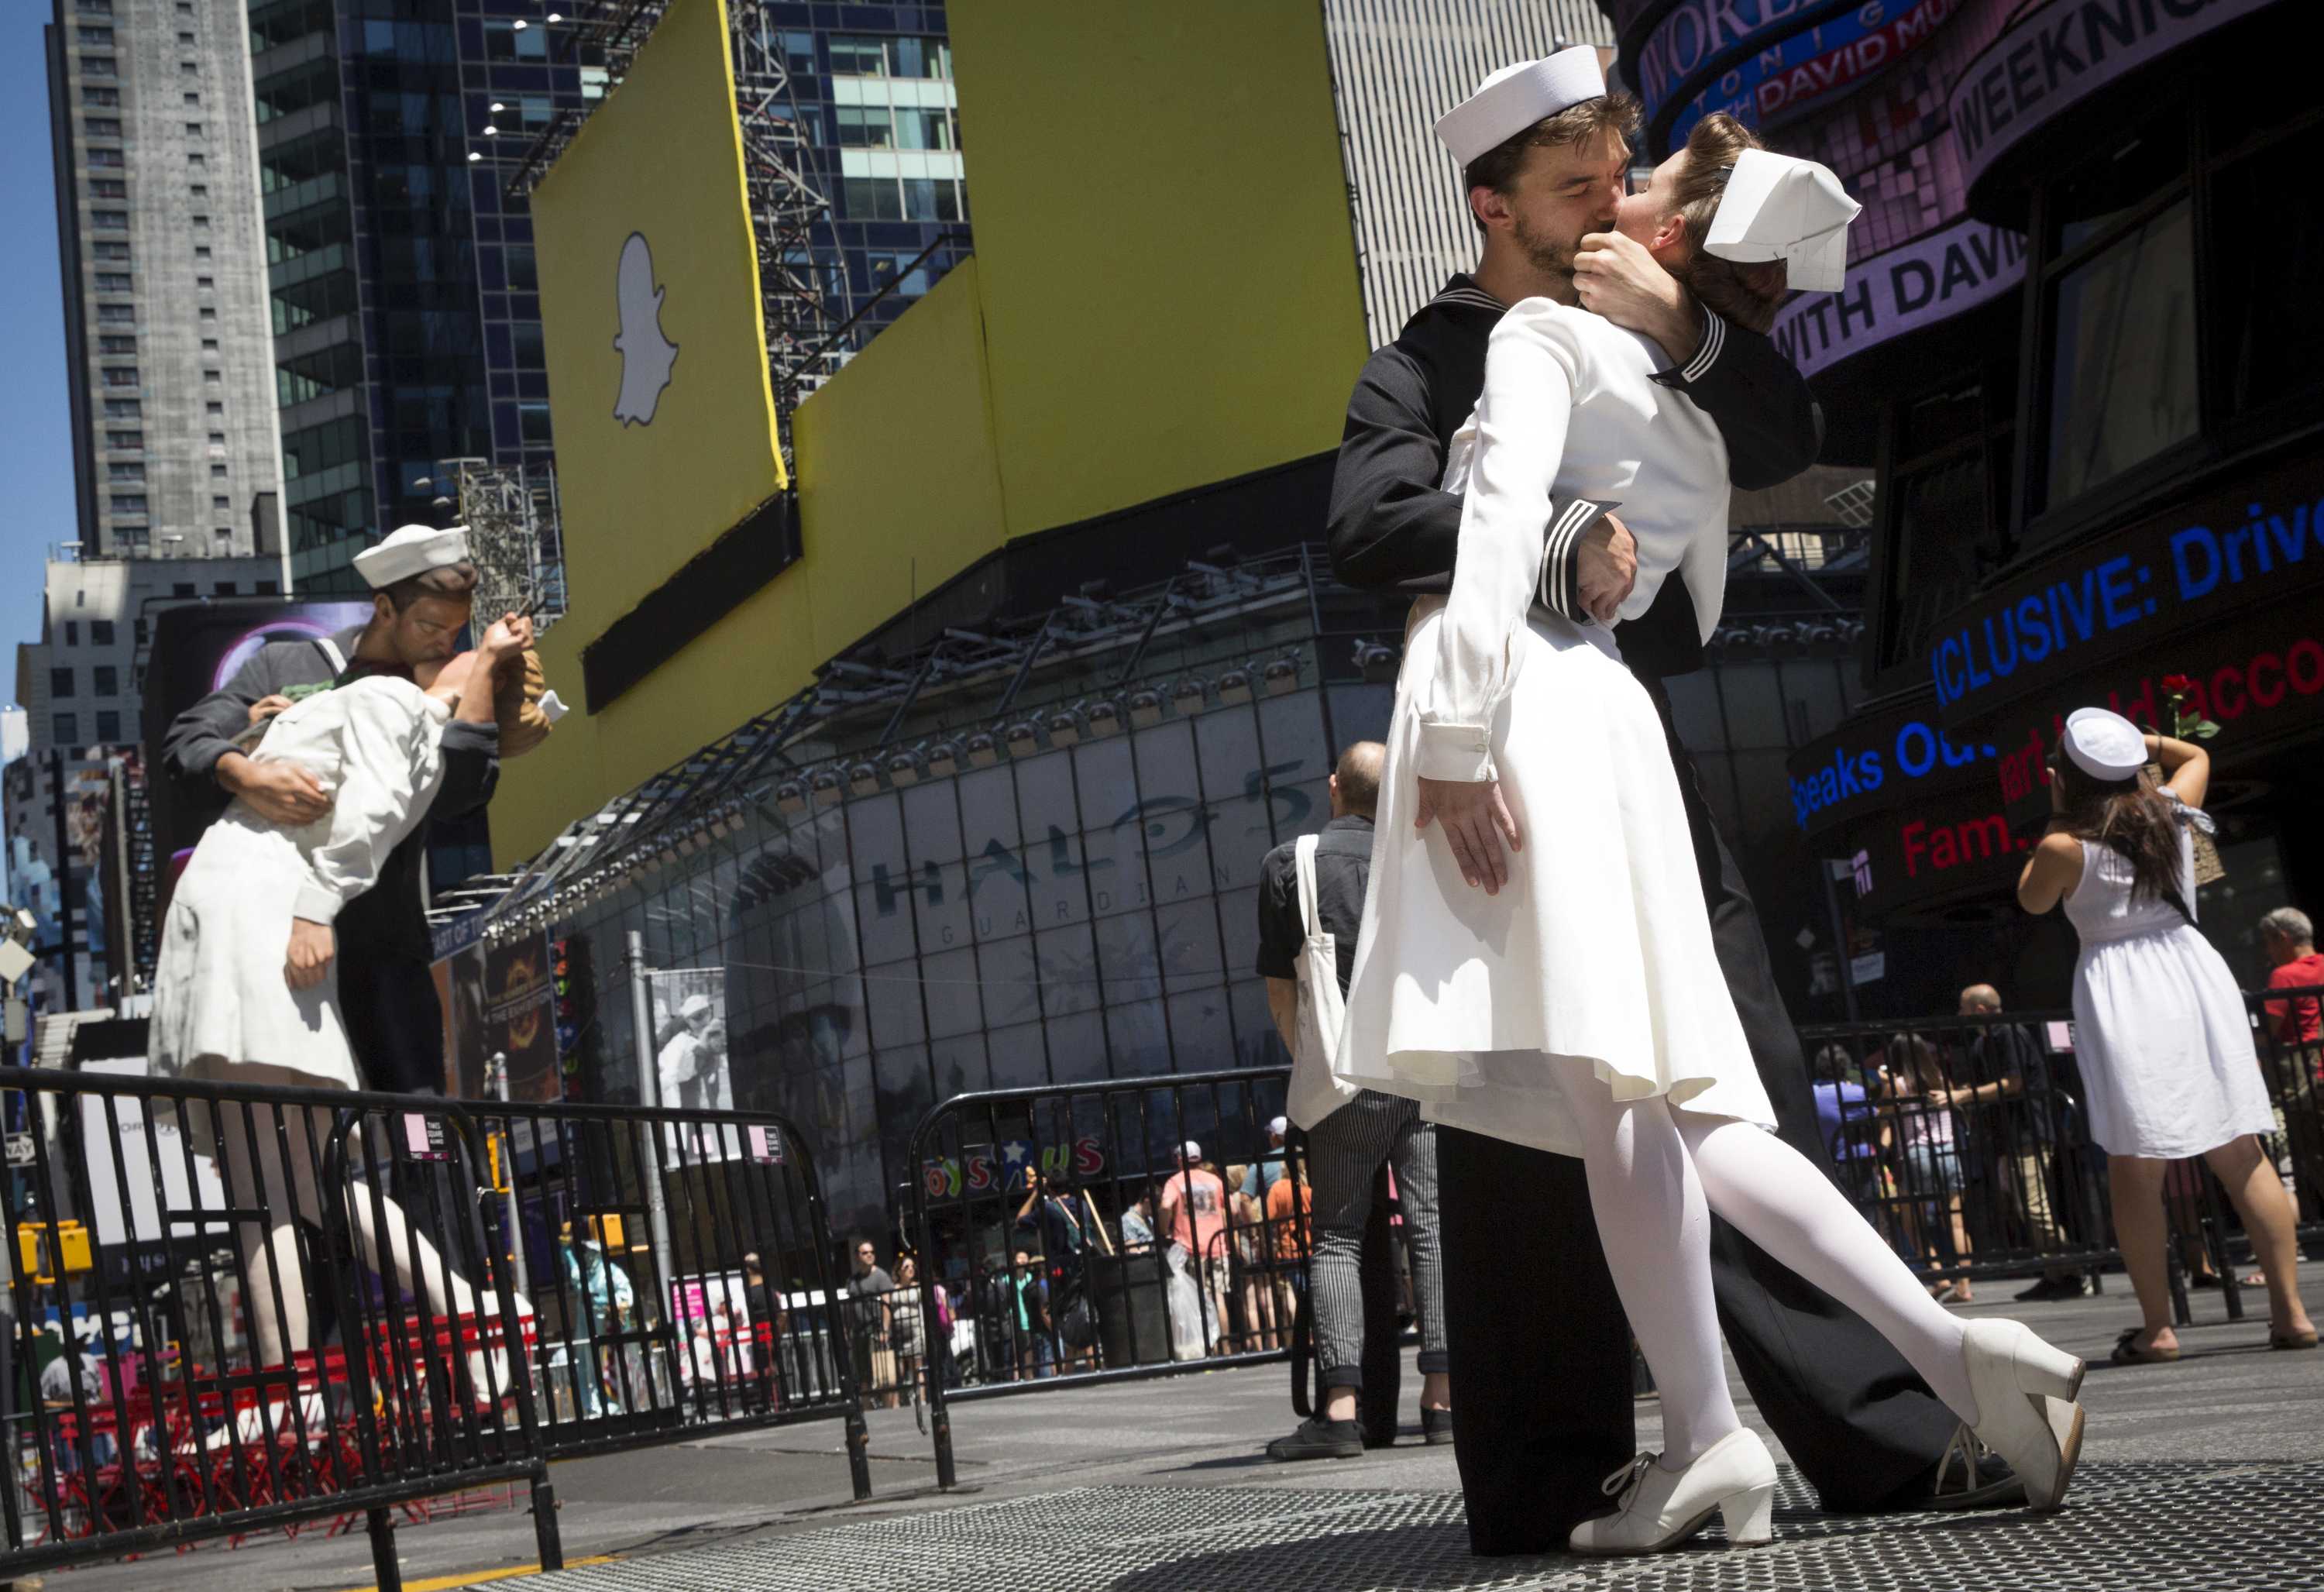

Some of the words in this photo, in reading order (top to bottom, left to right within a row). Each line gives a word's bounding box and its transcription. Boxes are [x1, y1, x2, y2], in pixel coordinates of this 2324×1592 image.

[1758, 33, 1888, 115] DAVID
[1896, 0, 1954, 50] MU
[1956, 0, 2206, 160] WEEKNI
[1789, 744, 1885, 830] peaks
[872, 796, 1219, 917] HALO
[1245, 759, 1312, 835] 5
[941, 860, 1232, 944] GUARDIAN
[923, 1156, 991, 1197] OYS
